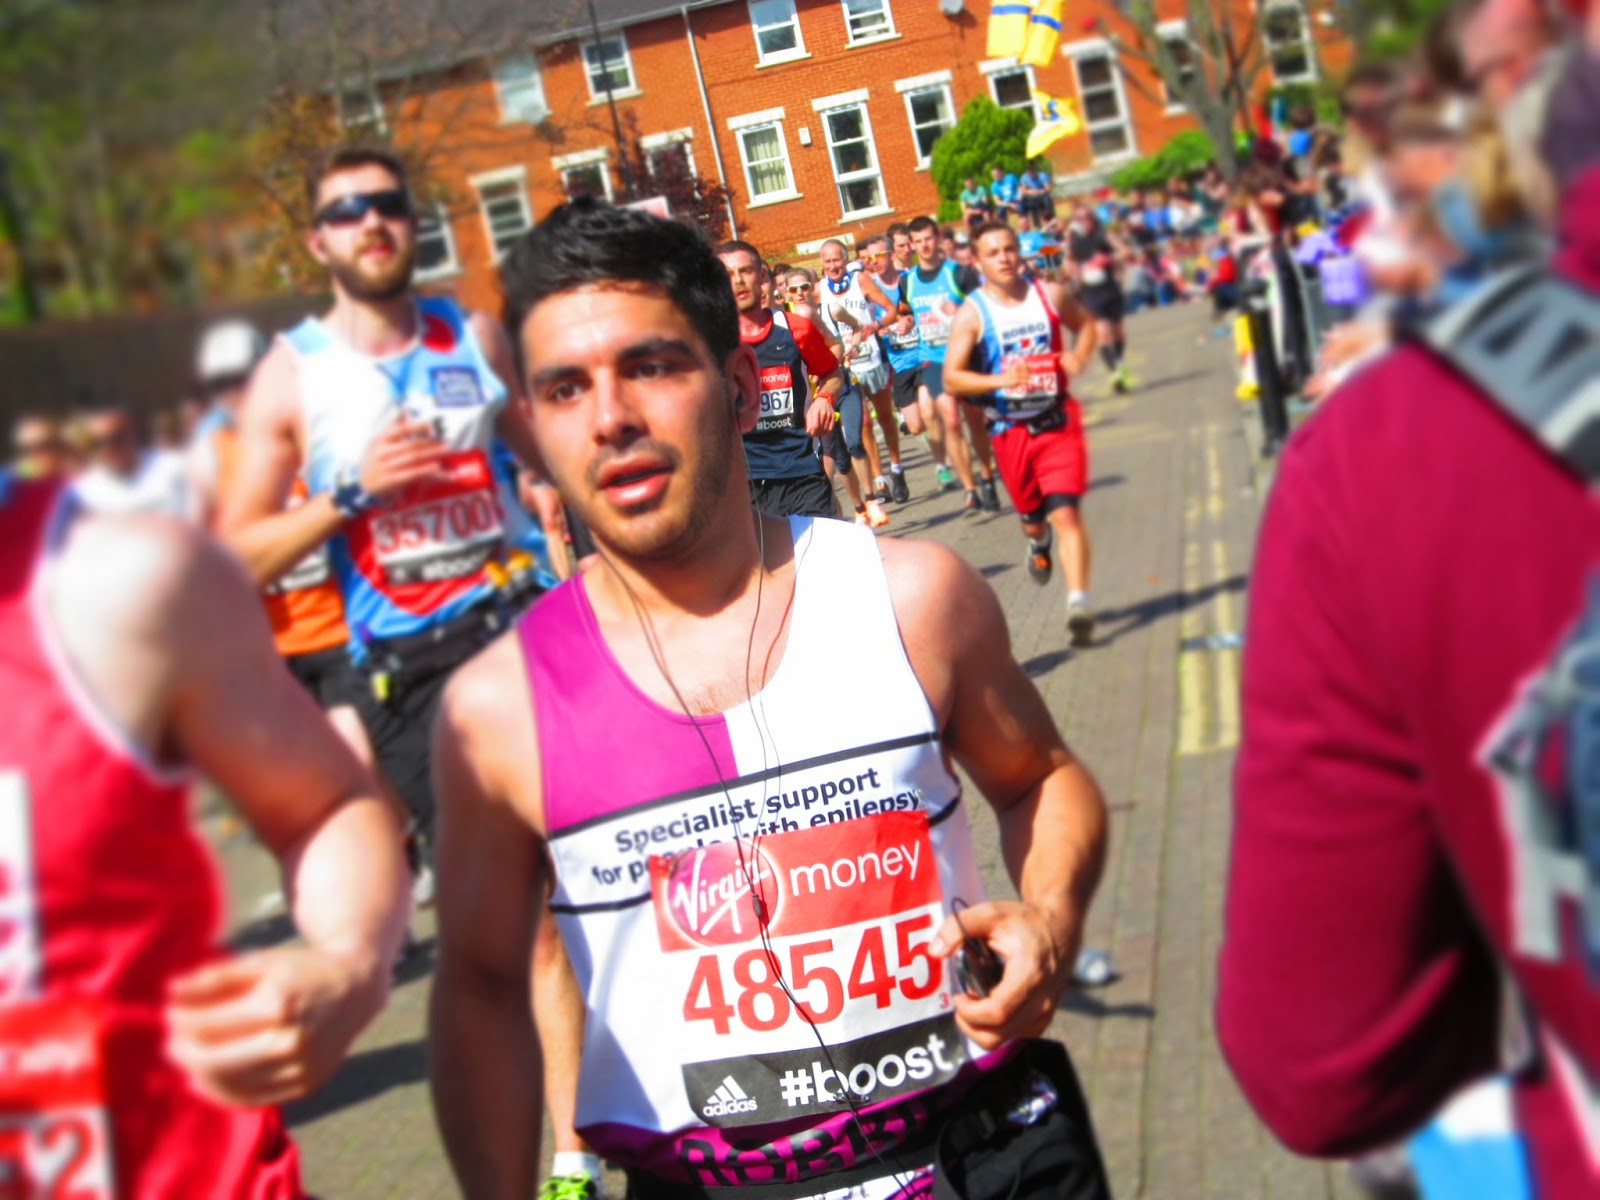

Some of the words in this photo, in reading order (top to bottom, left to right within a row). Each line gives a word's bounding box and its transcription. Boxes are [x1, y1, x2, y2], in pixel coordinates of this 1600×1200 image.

[756, 416, 792, 431] #boost
[760, 390, 791, 411] 967
[375, 492, 496, 553] 35700
[615, 798, 758, 854] Specialist
[766, 768, 881, 813] support
[592, 866, 623, 885] for
[673, 850, 770, 936] Virgin
[790, 840, 921, 896] money
[683, 914, 943, 1035] 48545
[703, 1096, 757, 1117] adidas
[779, 1033, 958, 1107] #boost
